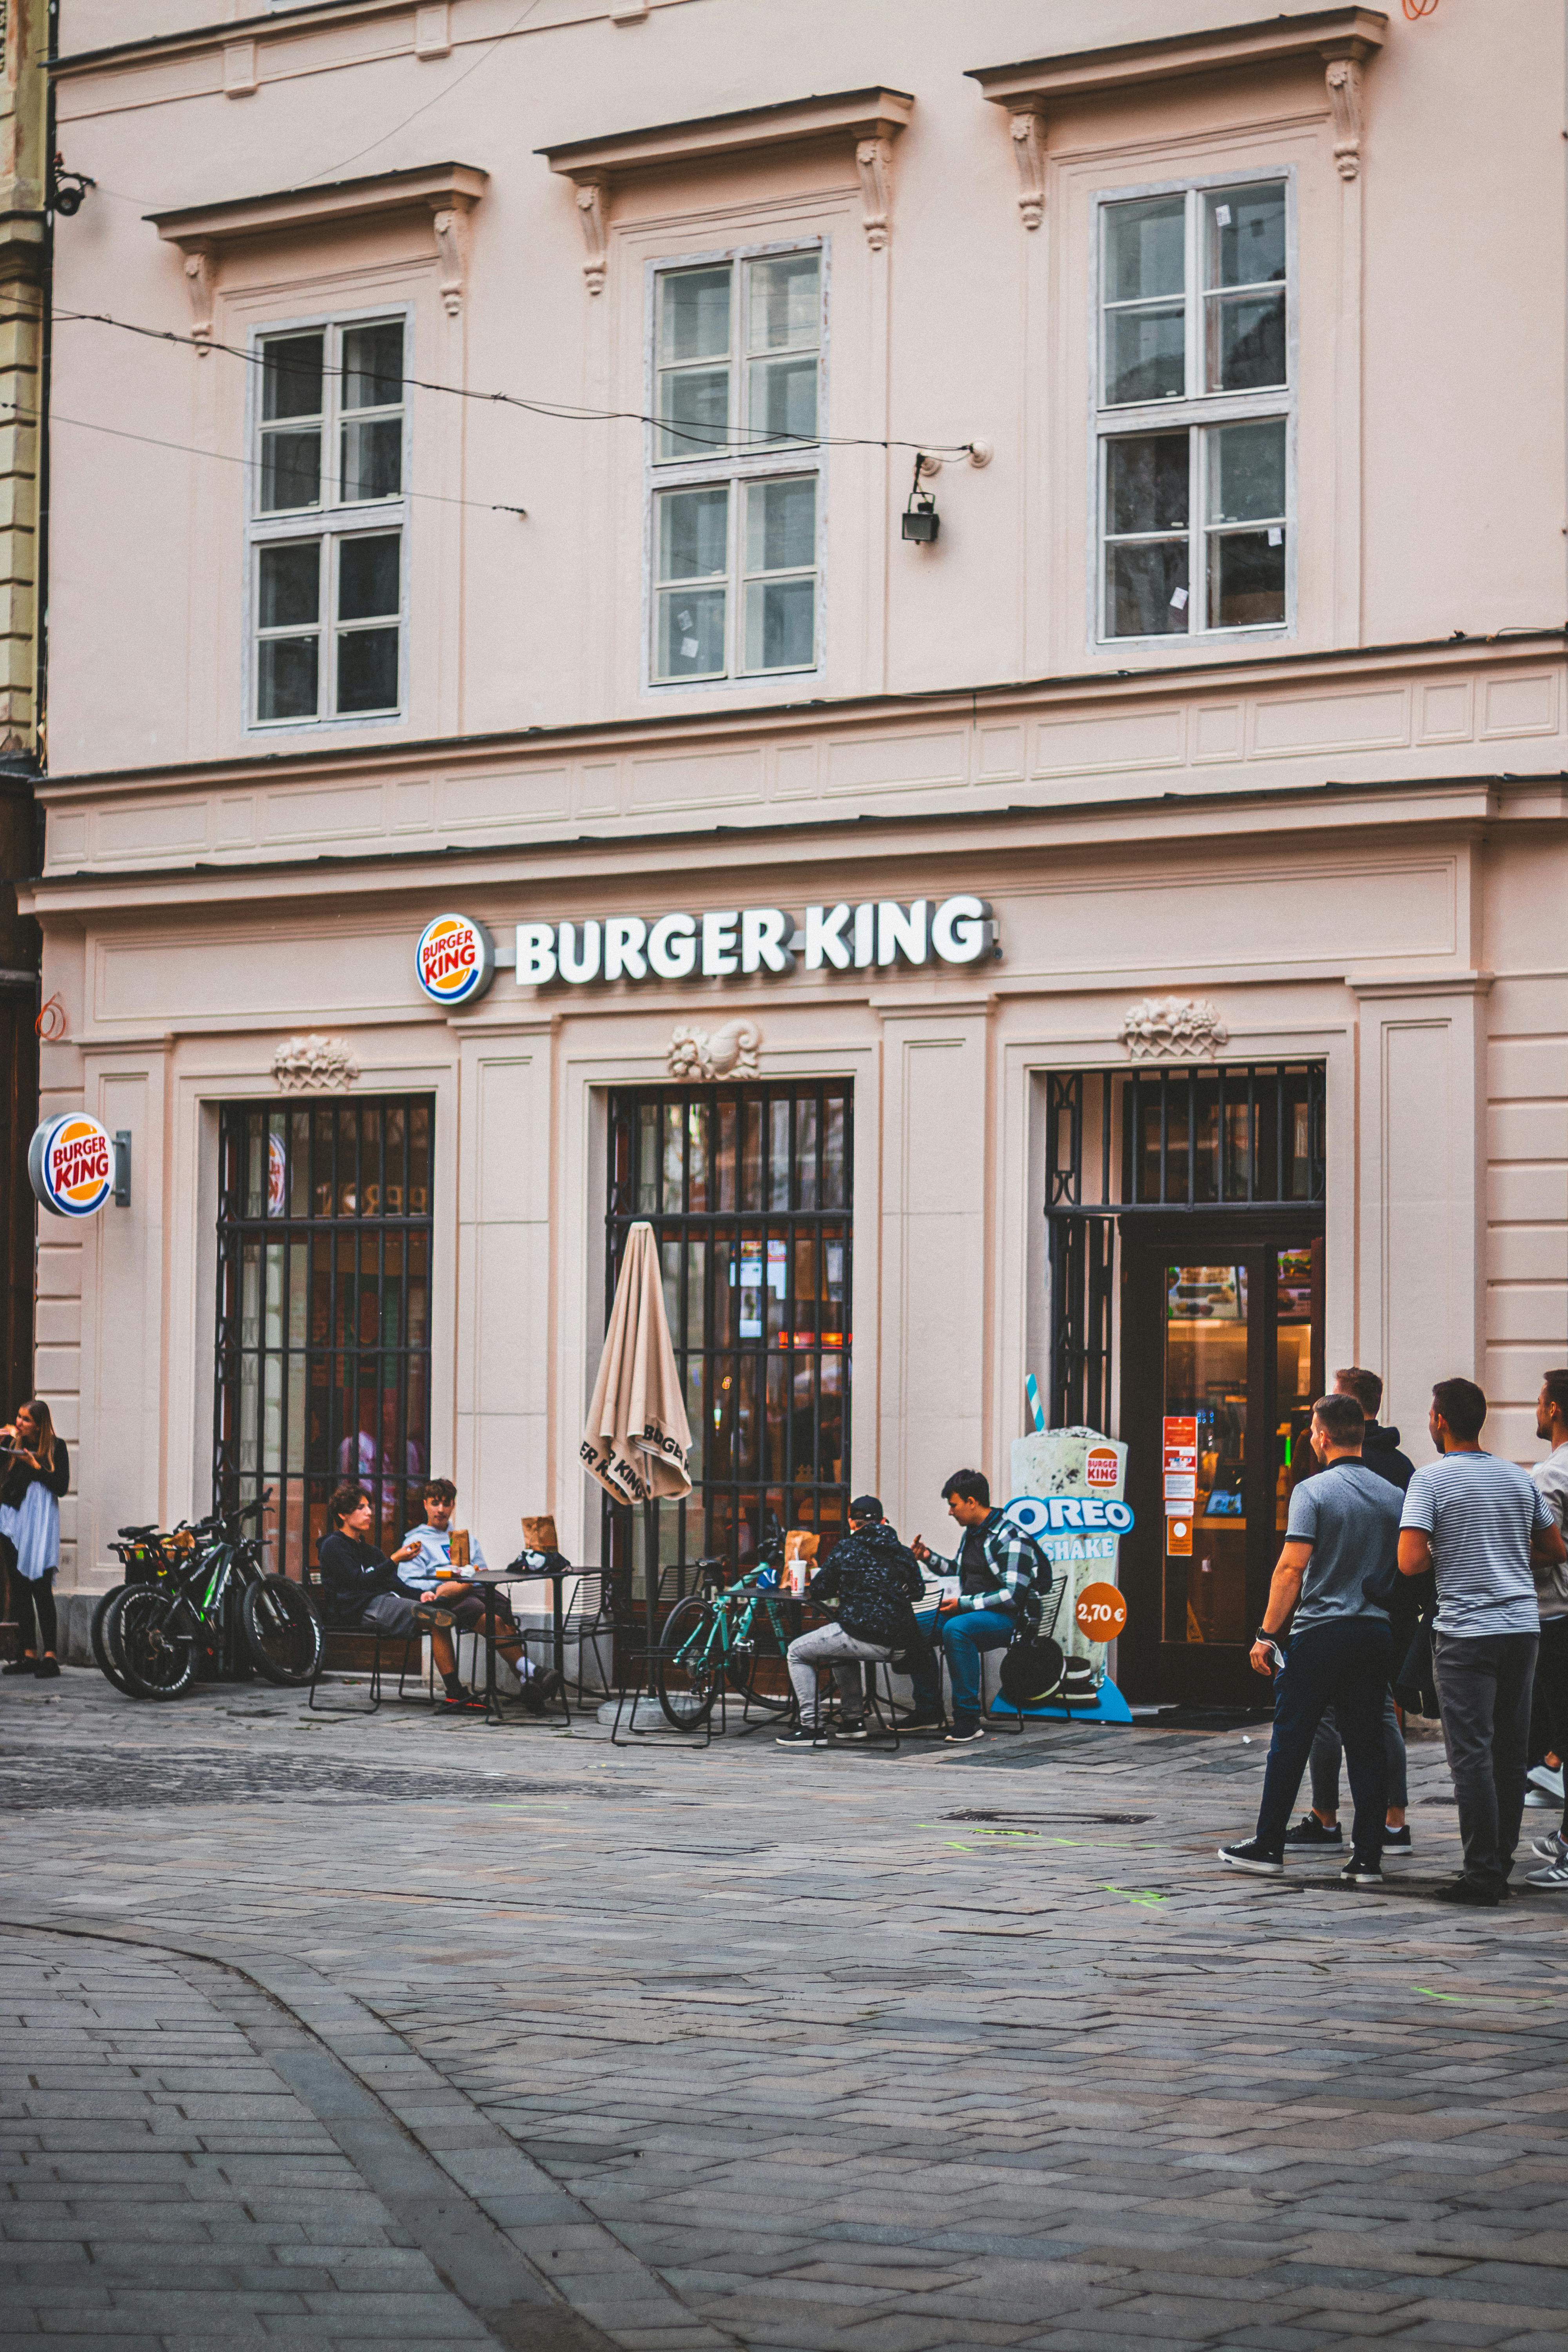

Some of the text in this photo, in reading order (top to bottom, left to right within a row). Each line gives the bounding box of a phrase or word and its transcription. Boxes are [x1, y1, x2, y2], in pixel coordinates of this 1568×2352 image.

[423, 929, 473, 963] BURGER
[515, 895, 985, 985] BURGER KING
[425, 944, 475, 986] KING
[53, 1136, 106, 1168] BURGER
[55, 1153, 108, 1192] KING
[1088, 1460, 1117, 1468] BURGER
[1088, 1468, 1117, 1479] KING
[1006, 1499, 1131, 1535] OREO
[1042, 1537, 1114, 1561] SHAKE
[1078, 1603, 1124, 1623] 2,70 €
